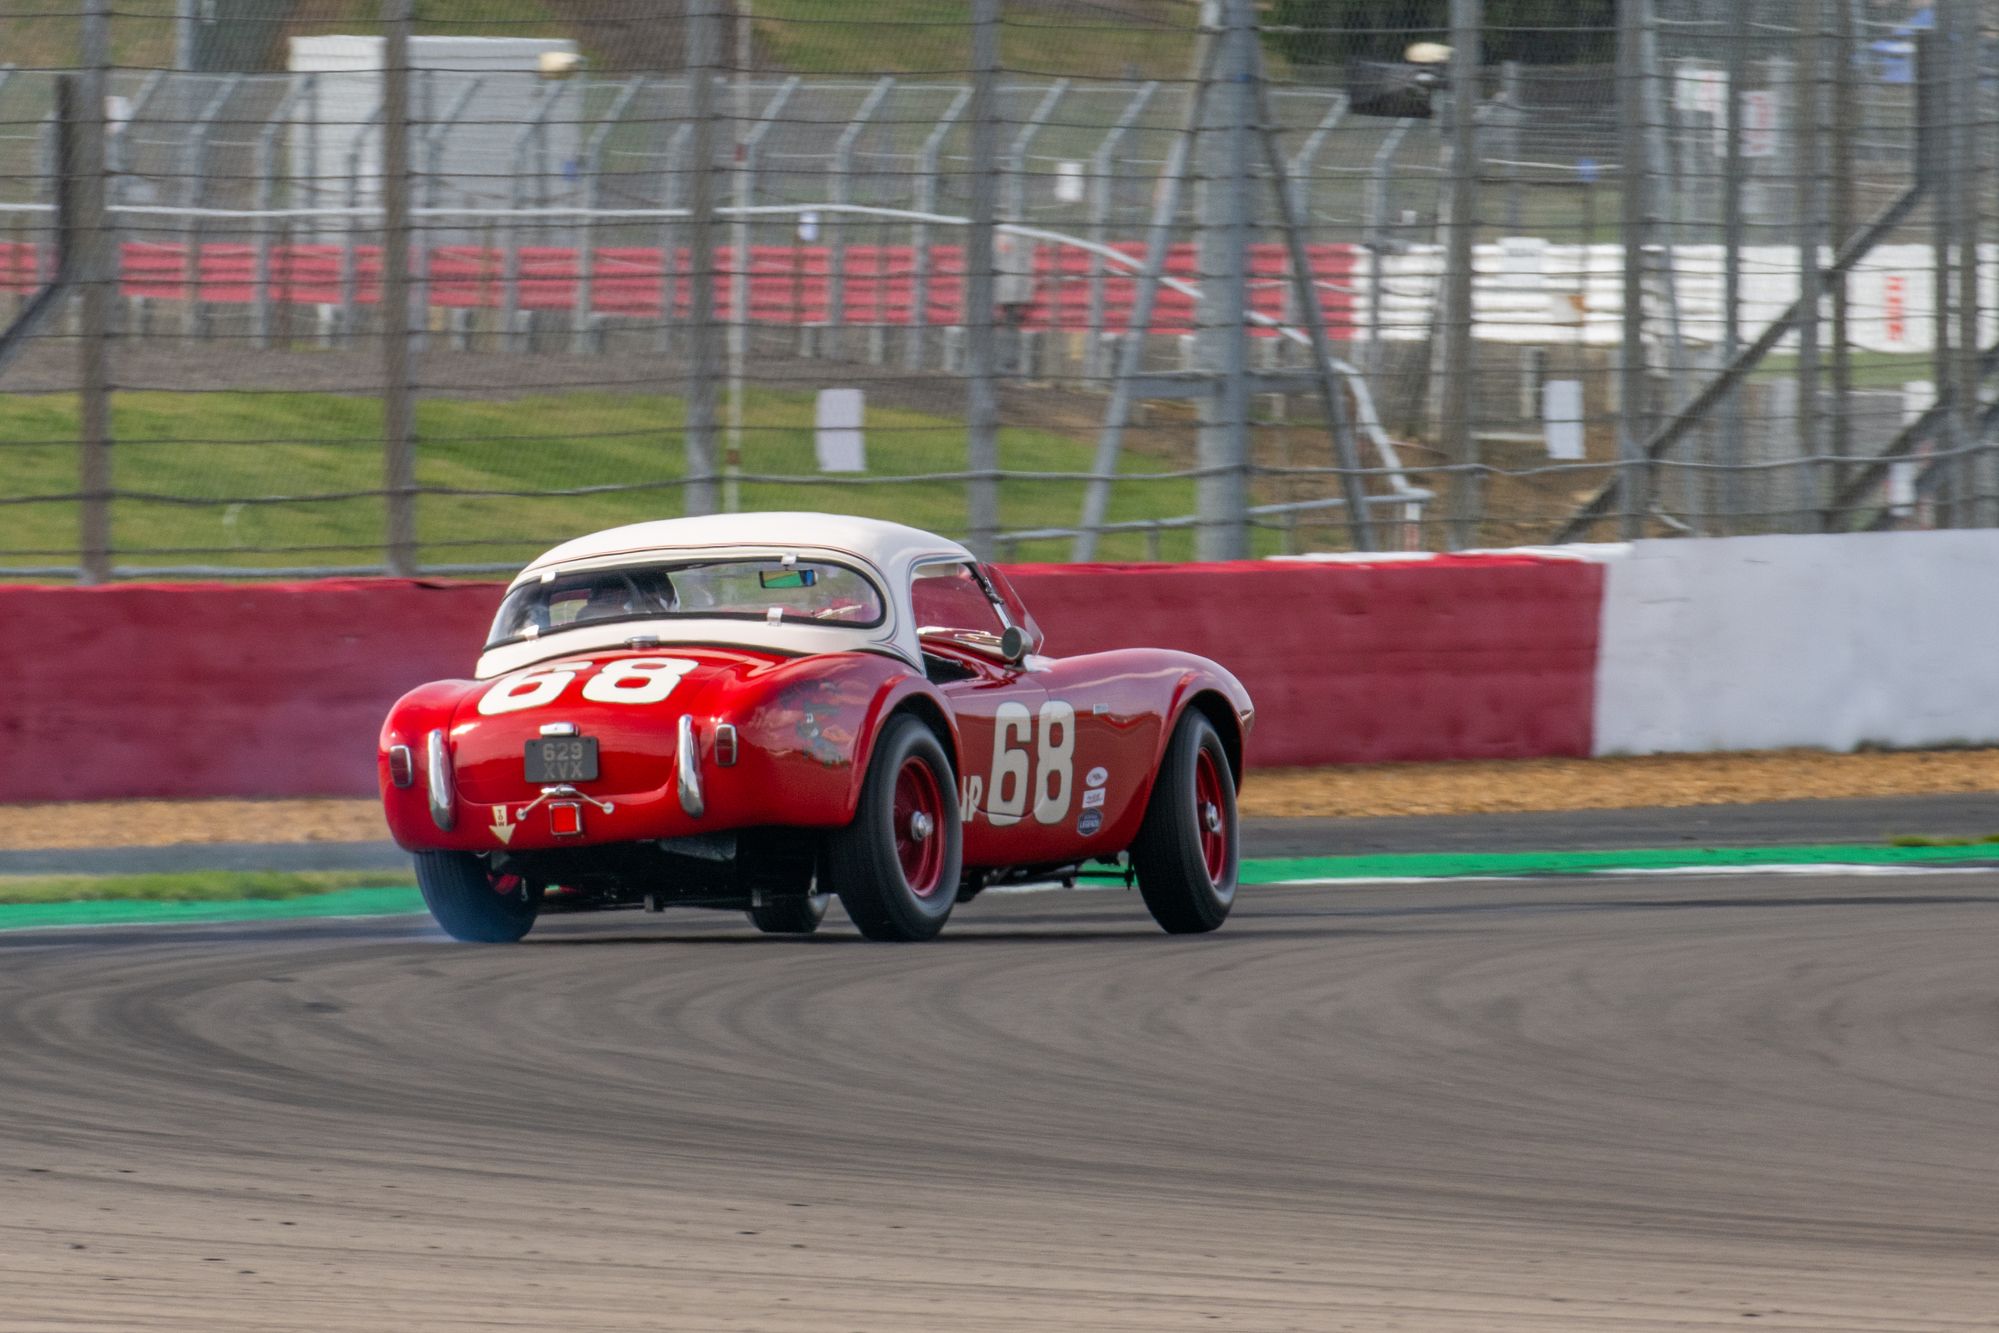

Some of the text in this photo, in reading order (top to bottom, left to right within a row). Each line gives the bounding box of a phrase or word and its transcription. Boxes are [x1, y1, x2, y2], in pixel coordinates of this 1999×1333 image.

[478, 657, 699, 716] 68
[543, 742, 583, 761] 629
[543, 761, 583, 779] XVX
[987, 700, 1076, 827] 68
